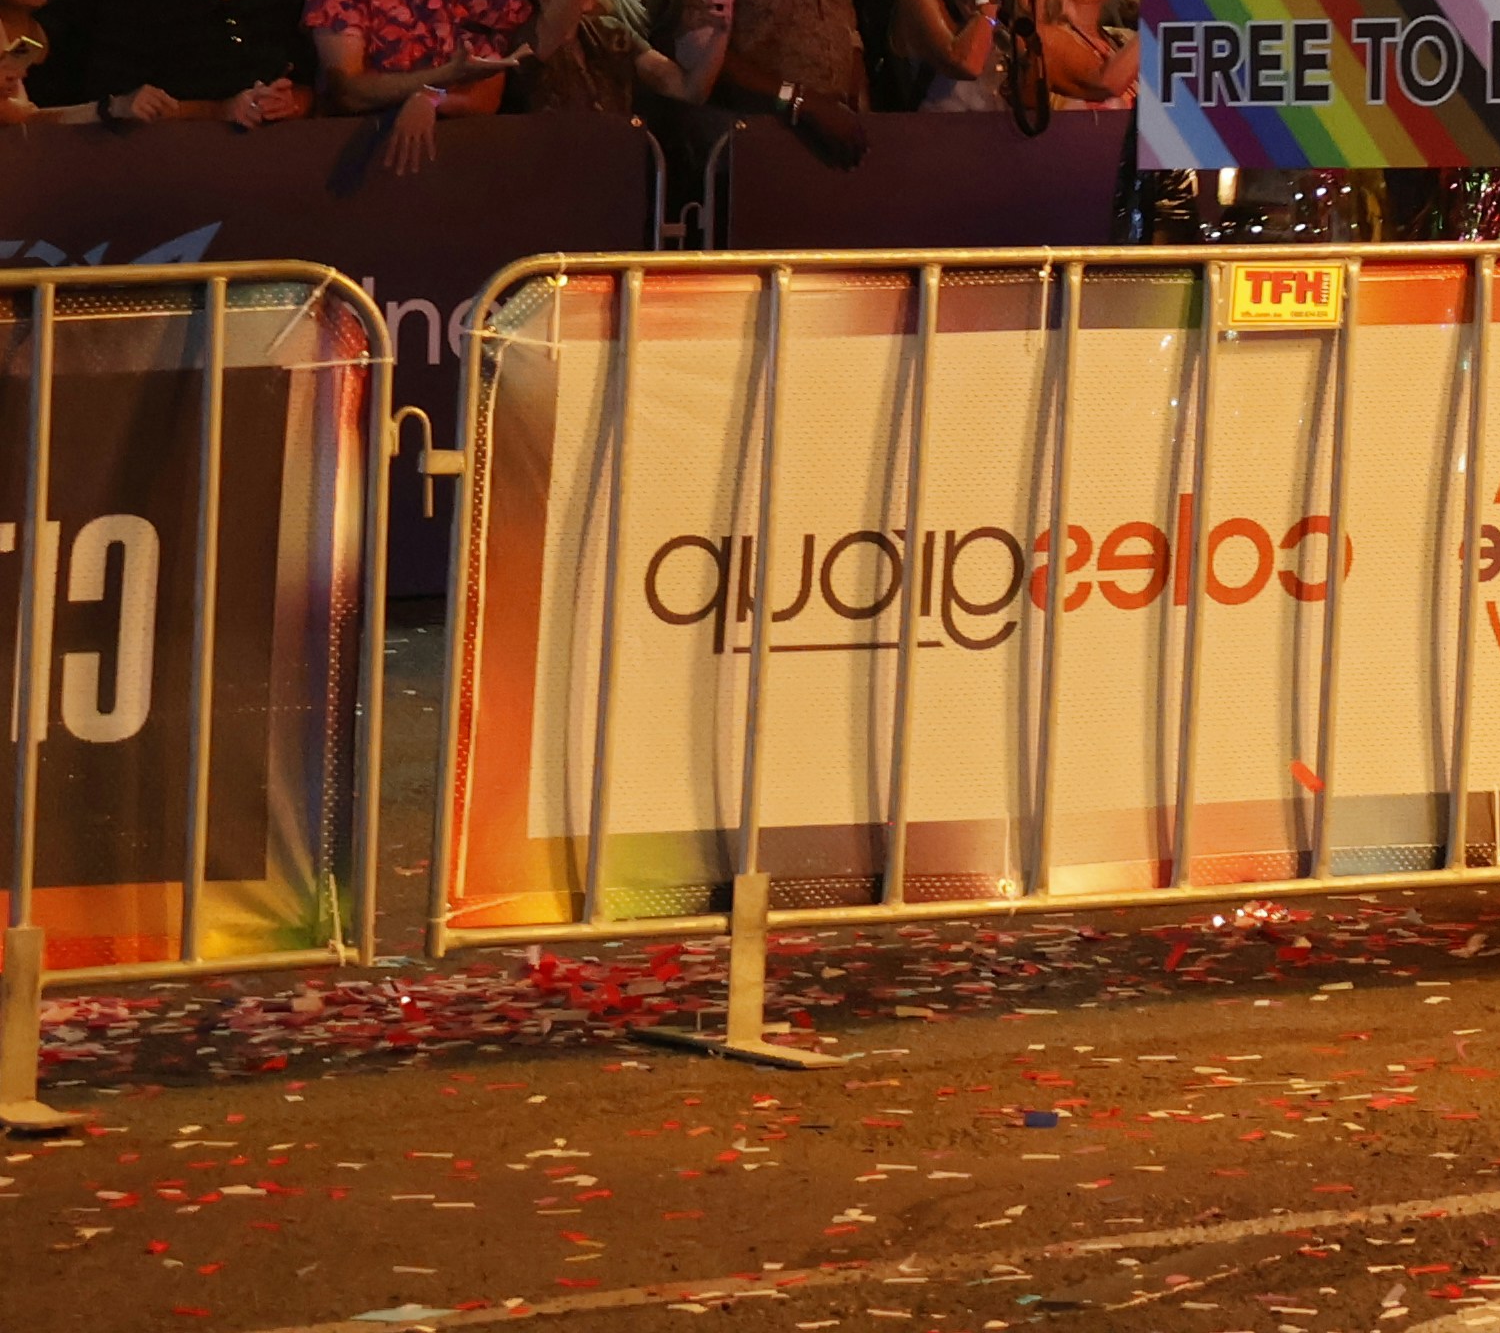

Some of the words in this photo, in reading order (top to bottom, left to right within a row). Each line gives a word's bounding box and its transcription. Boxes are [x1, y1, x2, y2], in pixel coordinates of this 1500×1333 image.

[1159, 19, 1332, 107] FREE
[1352, 15, 1464, 106] TO
[1245, 270, 1323, 304] TFH
